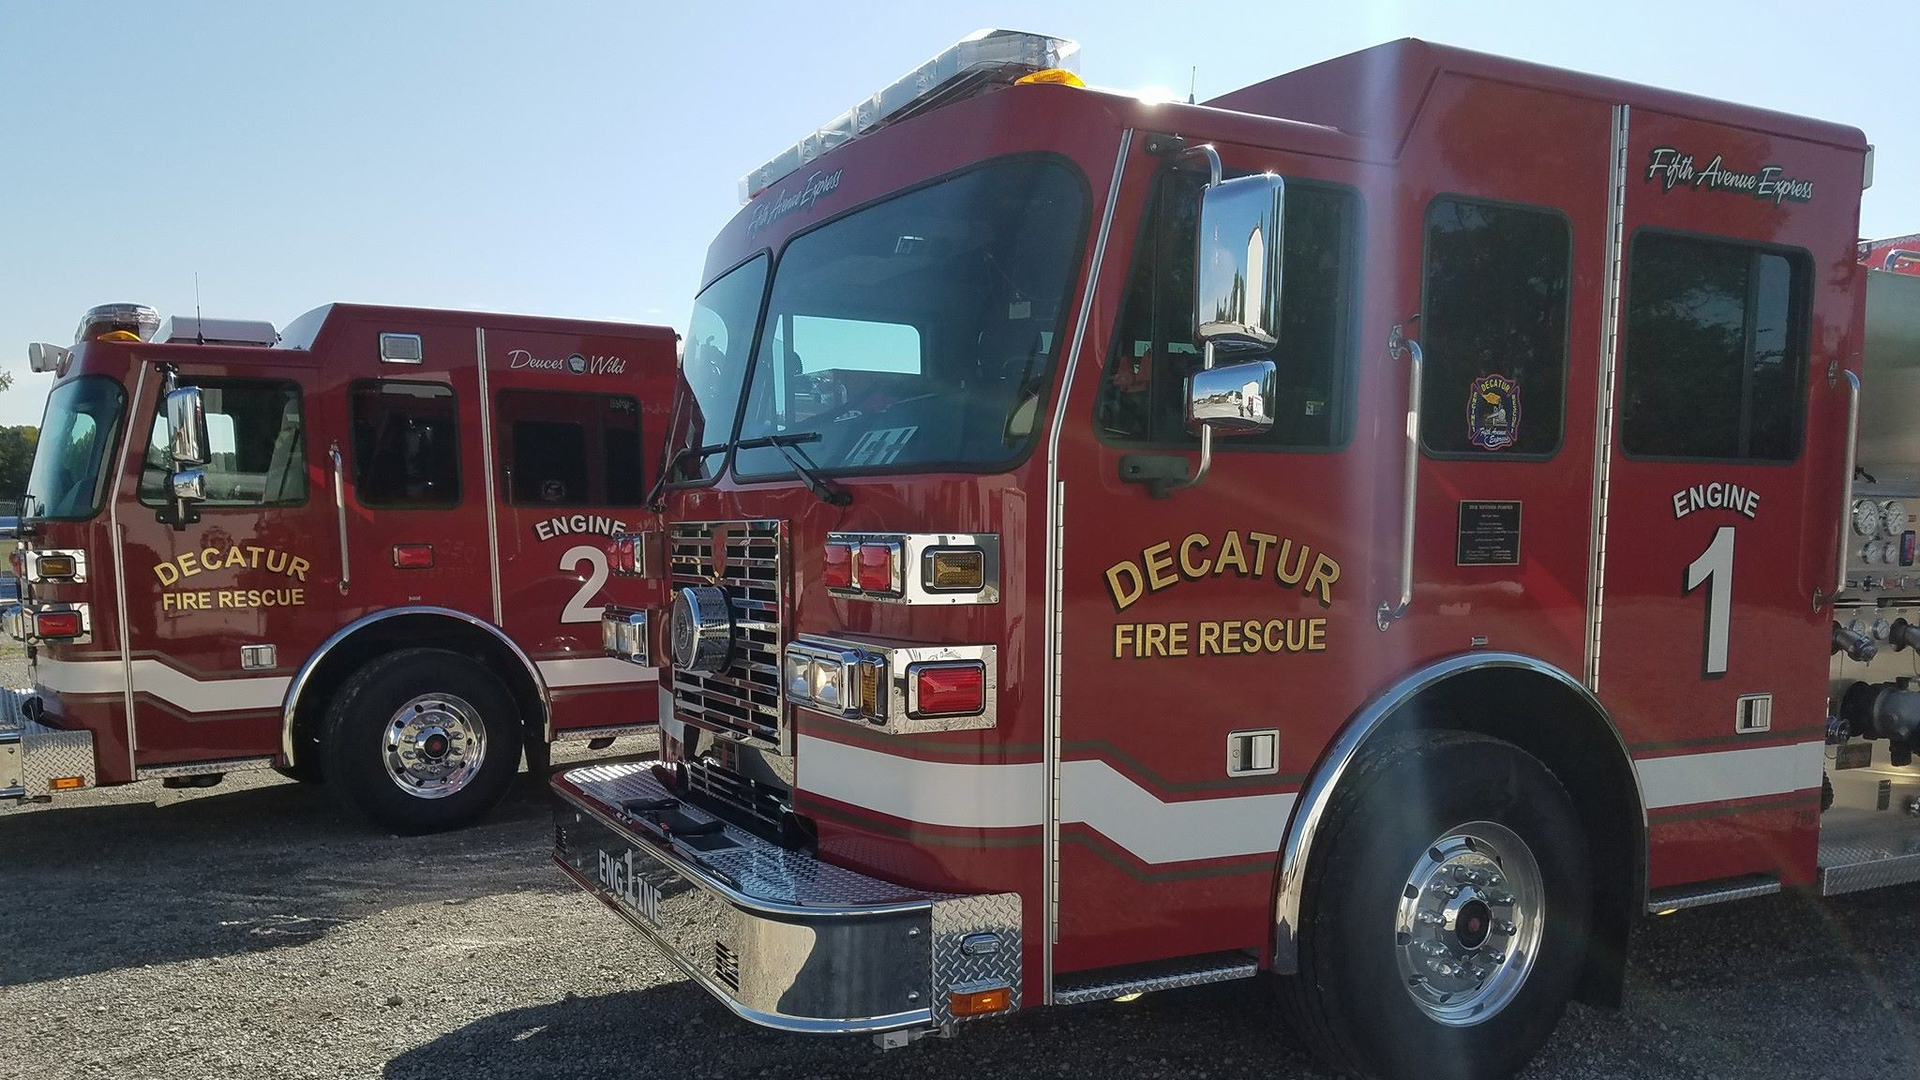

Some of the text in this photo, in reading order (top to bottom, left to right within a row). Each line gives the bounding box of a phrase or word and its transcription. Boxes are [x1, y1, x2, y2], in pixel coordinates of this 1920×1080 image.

[800, 169, 843, 207] Express
[1650, 148, 1813, 204] Fifth Avenue Express
[508, 349, 626, 375] Deuces Wild
[1480, 379, 1511, 393] DECATUR
[1673, 482, 1760, 519] ENGINE
[153, 545, 311, 587] DECATUR
[559, 545, 609, 624] 2
[1104, 530, 1342, 610] DECATUR
[163, 588, 306, 611] FIRE RESCUE
[1687, 526, 1736, 674] 1
[1114, 617, 1327, 658] FIRE RESCUE
